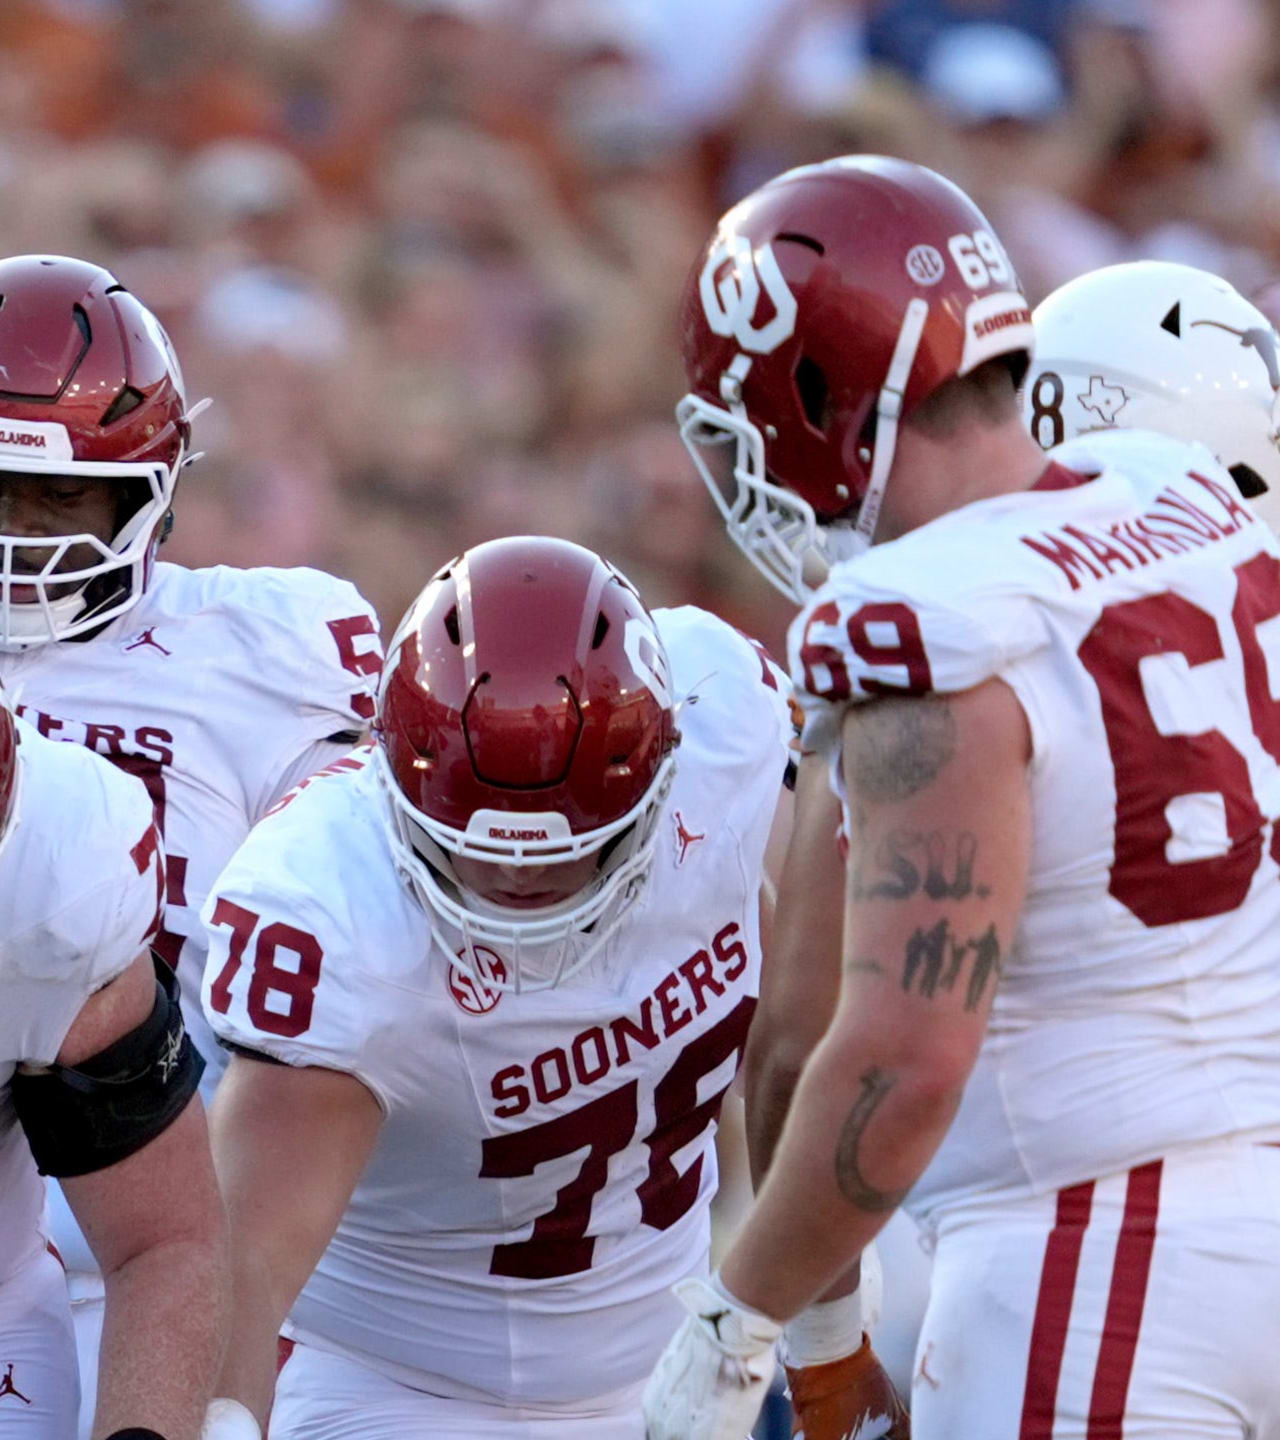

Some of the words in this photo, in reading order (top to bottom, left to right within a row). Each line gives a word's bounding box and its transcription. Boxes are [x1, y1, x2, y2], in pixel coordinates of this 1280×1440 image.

[907, 247, 943, 283] SEC
[948, 230, 1009, 290] 69
[1031, 371, 1065, 450] 8
[800, 600, 932, 702] 69
[489, 827, 548, 841] OKLAHOMA
[209, 896, 324, 1038] 78
[490, 921, 748, 1119] SOONERS
[478, 994, 760, 1280] 78
